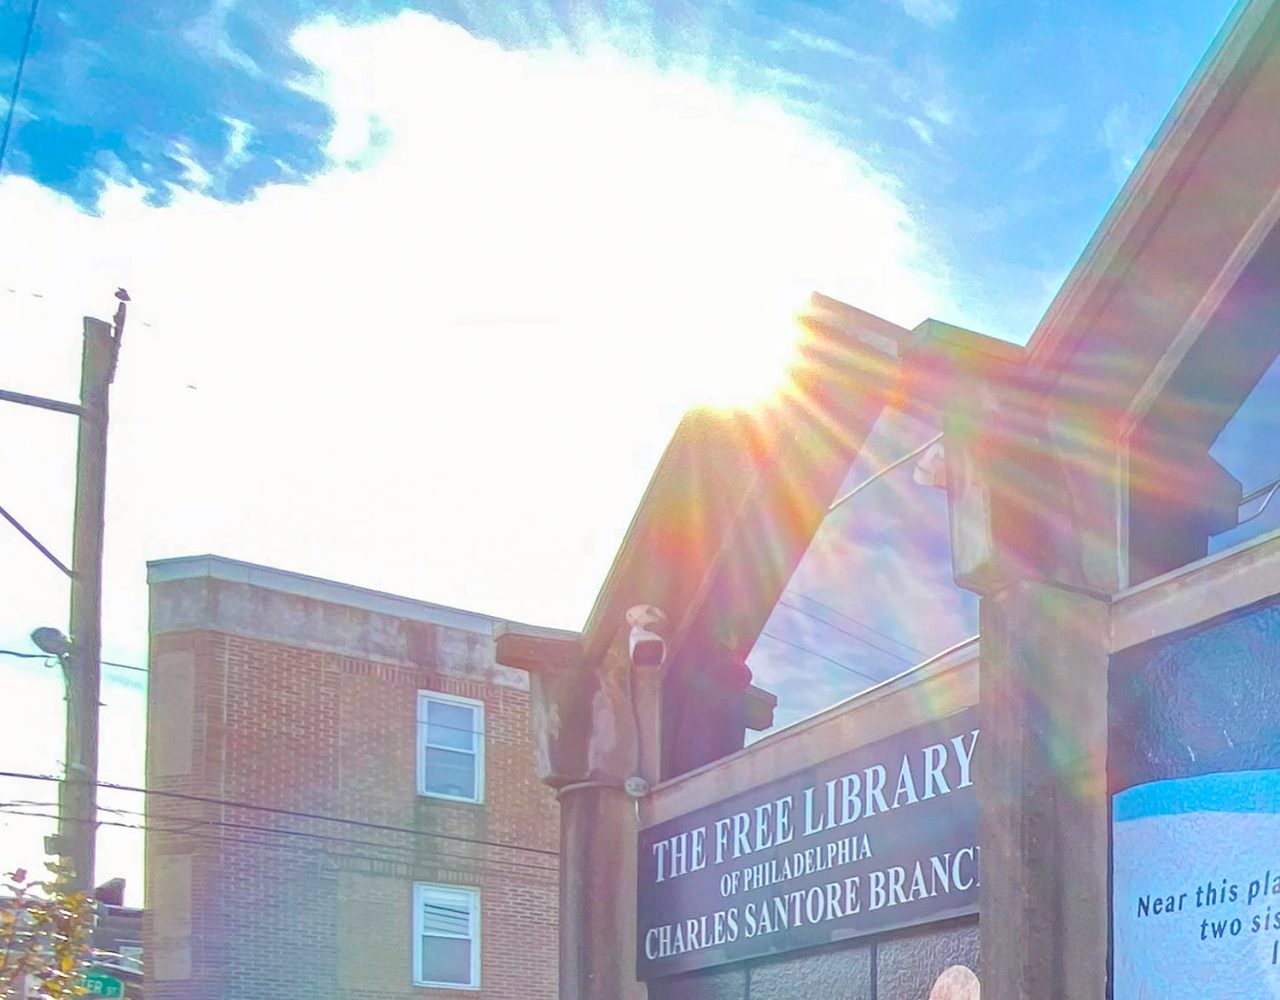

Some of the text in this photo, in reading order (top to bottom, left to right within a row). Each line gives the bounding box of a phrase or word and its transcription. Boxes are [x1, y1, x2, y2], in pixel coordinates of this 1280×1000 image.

[652, 729, 980, 883] THE FREE LIBRARY
[720, 833, 873, 898] OF PHILADELPHIA
[1137, 893, 1188, 918] Near
[1195, 878, 1239, 908] this
[645, 846, 980, 960] CHARLES SANTORE BRANC
[1200, 918, 1242, 941] two
